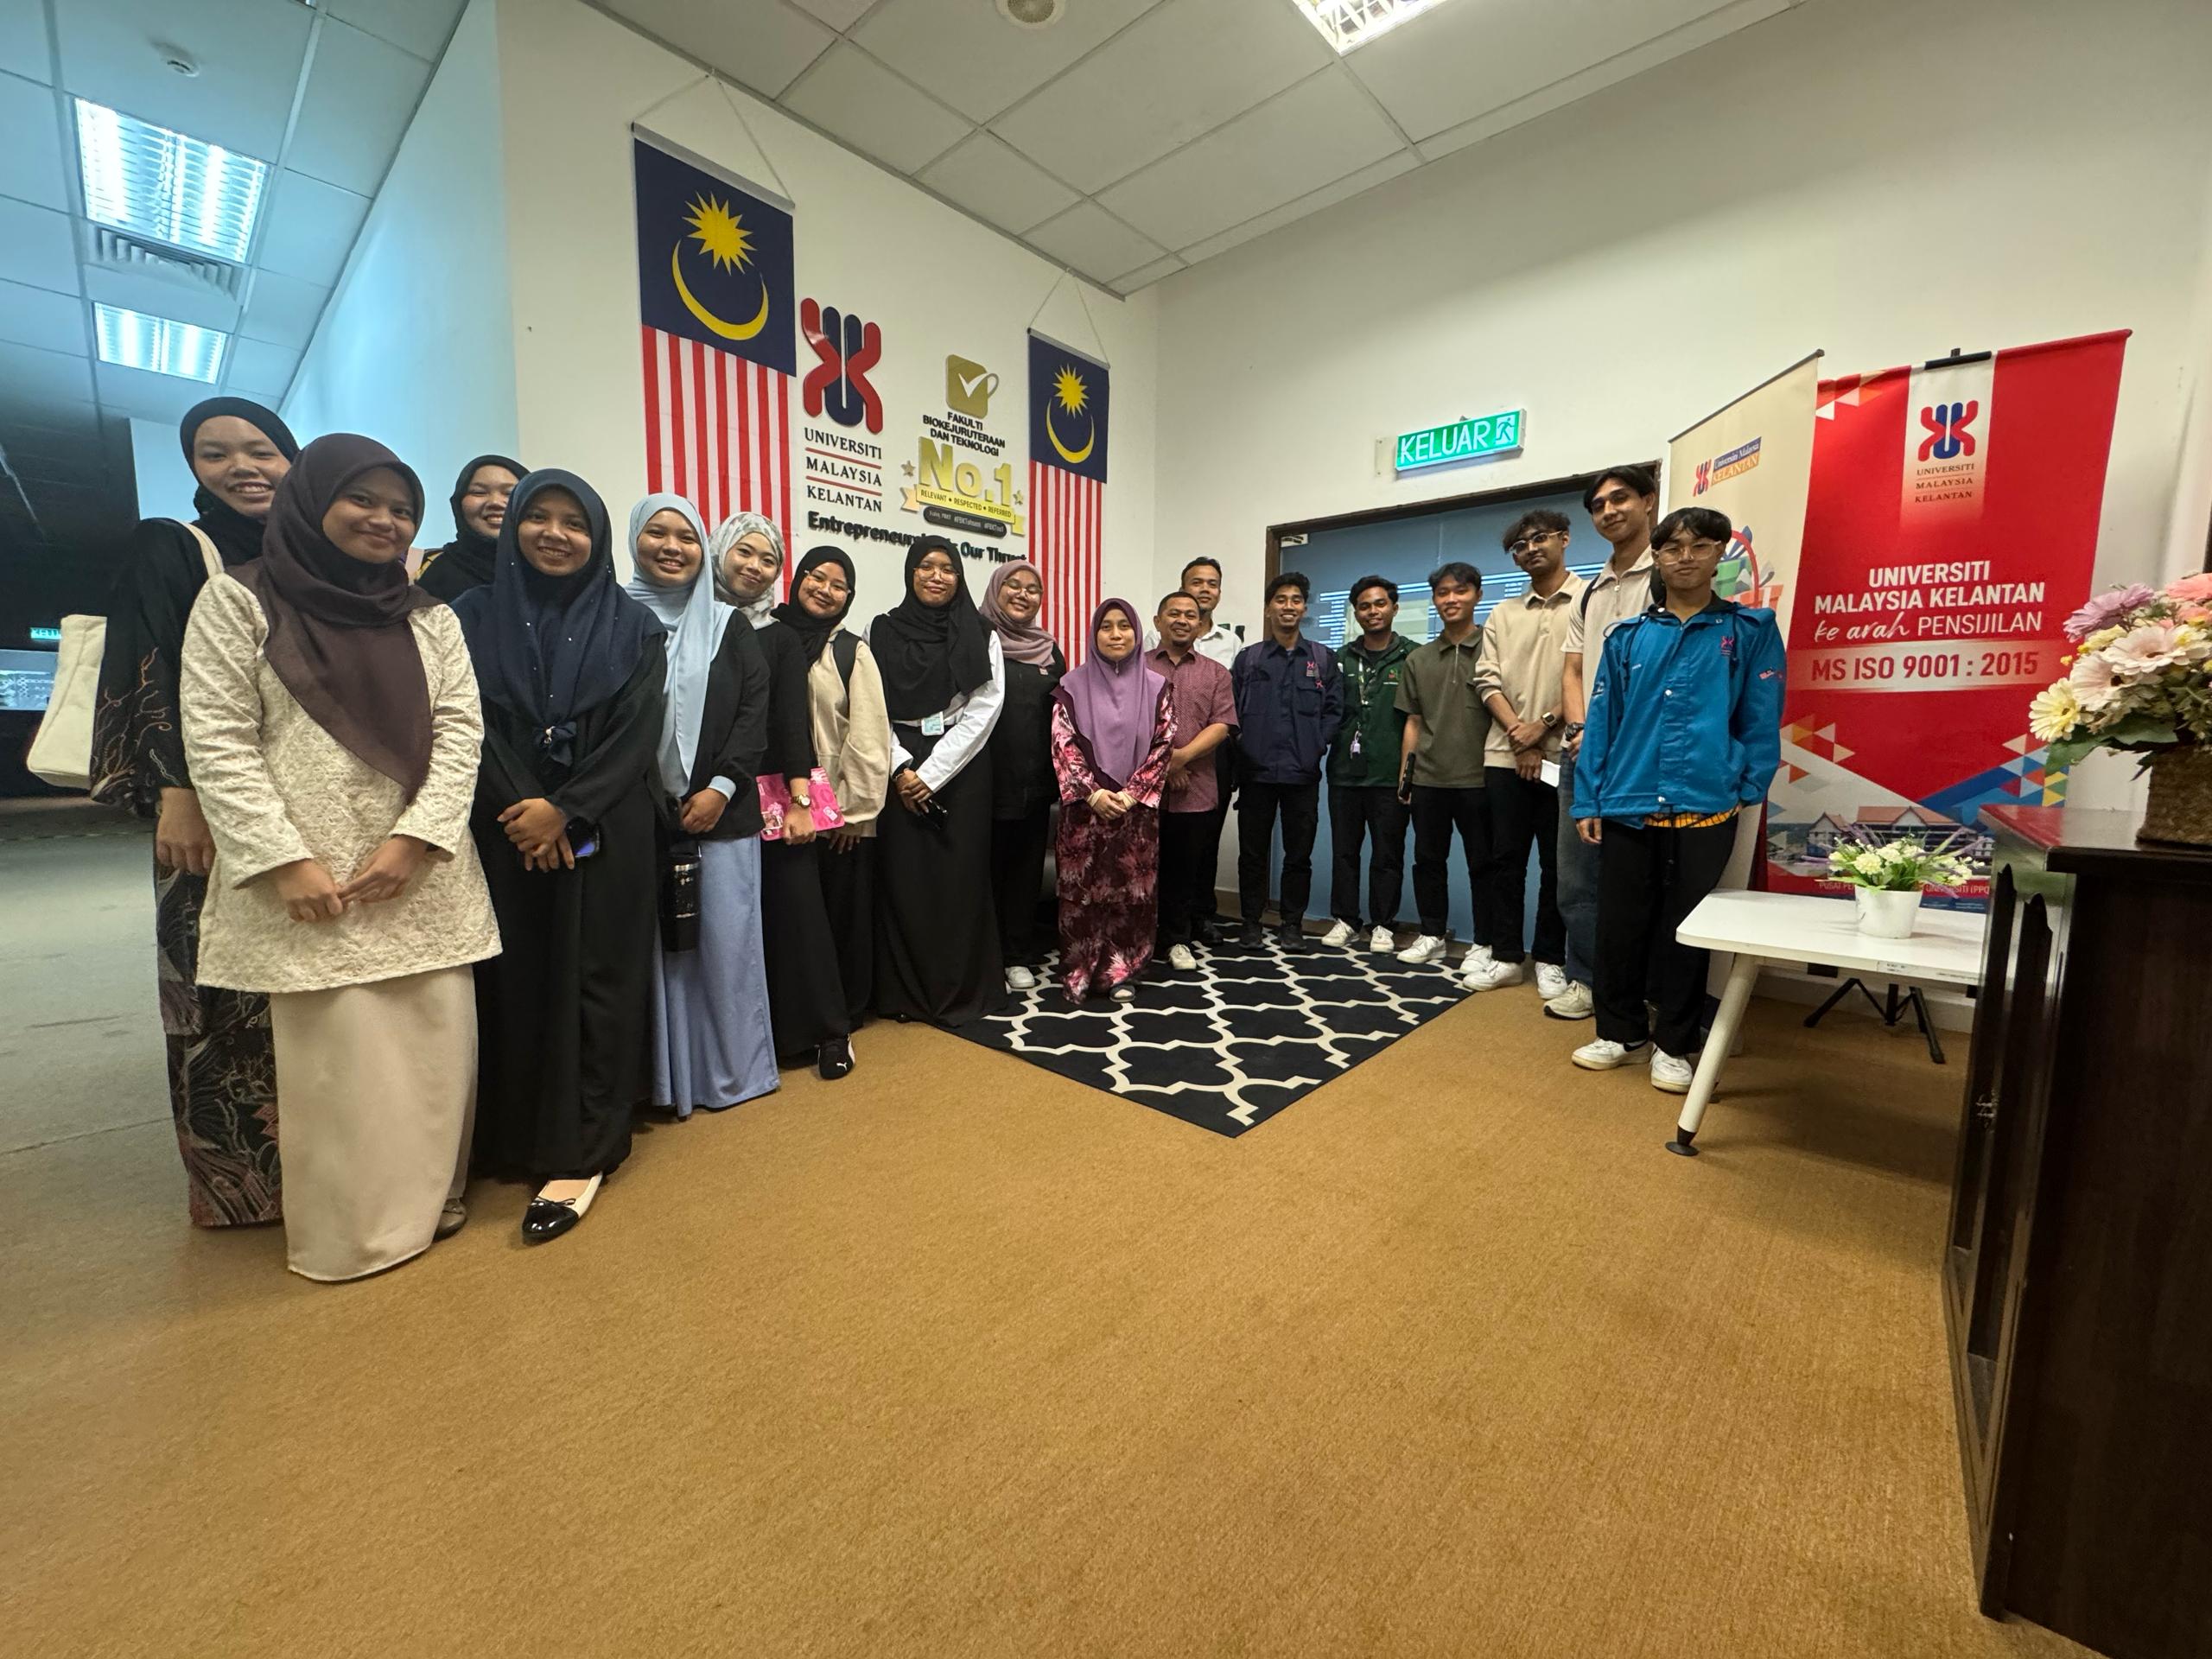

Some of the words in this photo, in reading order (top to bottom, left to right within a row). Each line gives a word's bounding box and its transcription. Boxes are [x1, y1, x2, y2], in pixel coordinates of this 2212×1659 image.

[922, 415, 1005, 448] BIOKEJURUTERAAN
[947, 411, 983, 430] FAKULTI
[804, 427, 881, 460] UNIVERSITI
[930, 428, 950, 442] DAN
[950, 434, 999, 456] TEKNOLOGI
[1400, 421, 1491, 464] KELUAR
[806, 456, 882, 486] MALAYSIA
[918, 435, 1011, 506] No.1
[1916, 463, 1974, 476] UNIVERSITI
[1916, 478, 1974, 490] MALAYSIA
[807, 485, 882, 512] KELANTAN
[920, 489, 947, 502] RELEVANT
[953, 498, 982, 511] RESPECTED
[988, 505, 1012, 518] REFERRED
[1915, 491, 1973, 503] KELANTAN
[808, 511, 925, 546] Entrepreneur
[961, 542, 985, 559] Our
[1868, 560, 1991, 588] UNIVERSITI
[1814, 588, 1923, 615] MALAYSIA
[1929, 582, 2045, 608] KELANTAN
[1814, 620, 1840, 643] ke
[1846, 611, 1910, 640] arah
[1917, 611, 2042, 637] PENSIJILAN
[1811, 658, 1847, 681] MS
[1853, 656, 1895, 680] ISO
[1903, 654, 1960, 678] 9001
[1980, 652, 2039, 677] 2015
